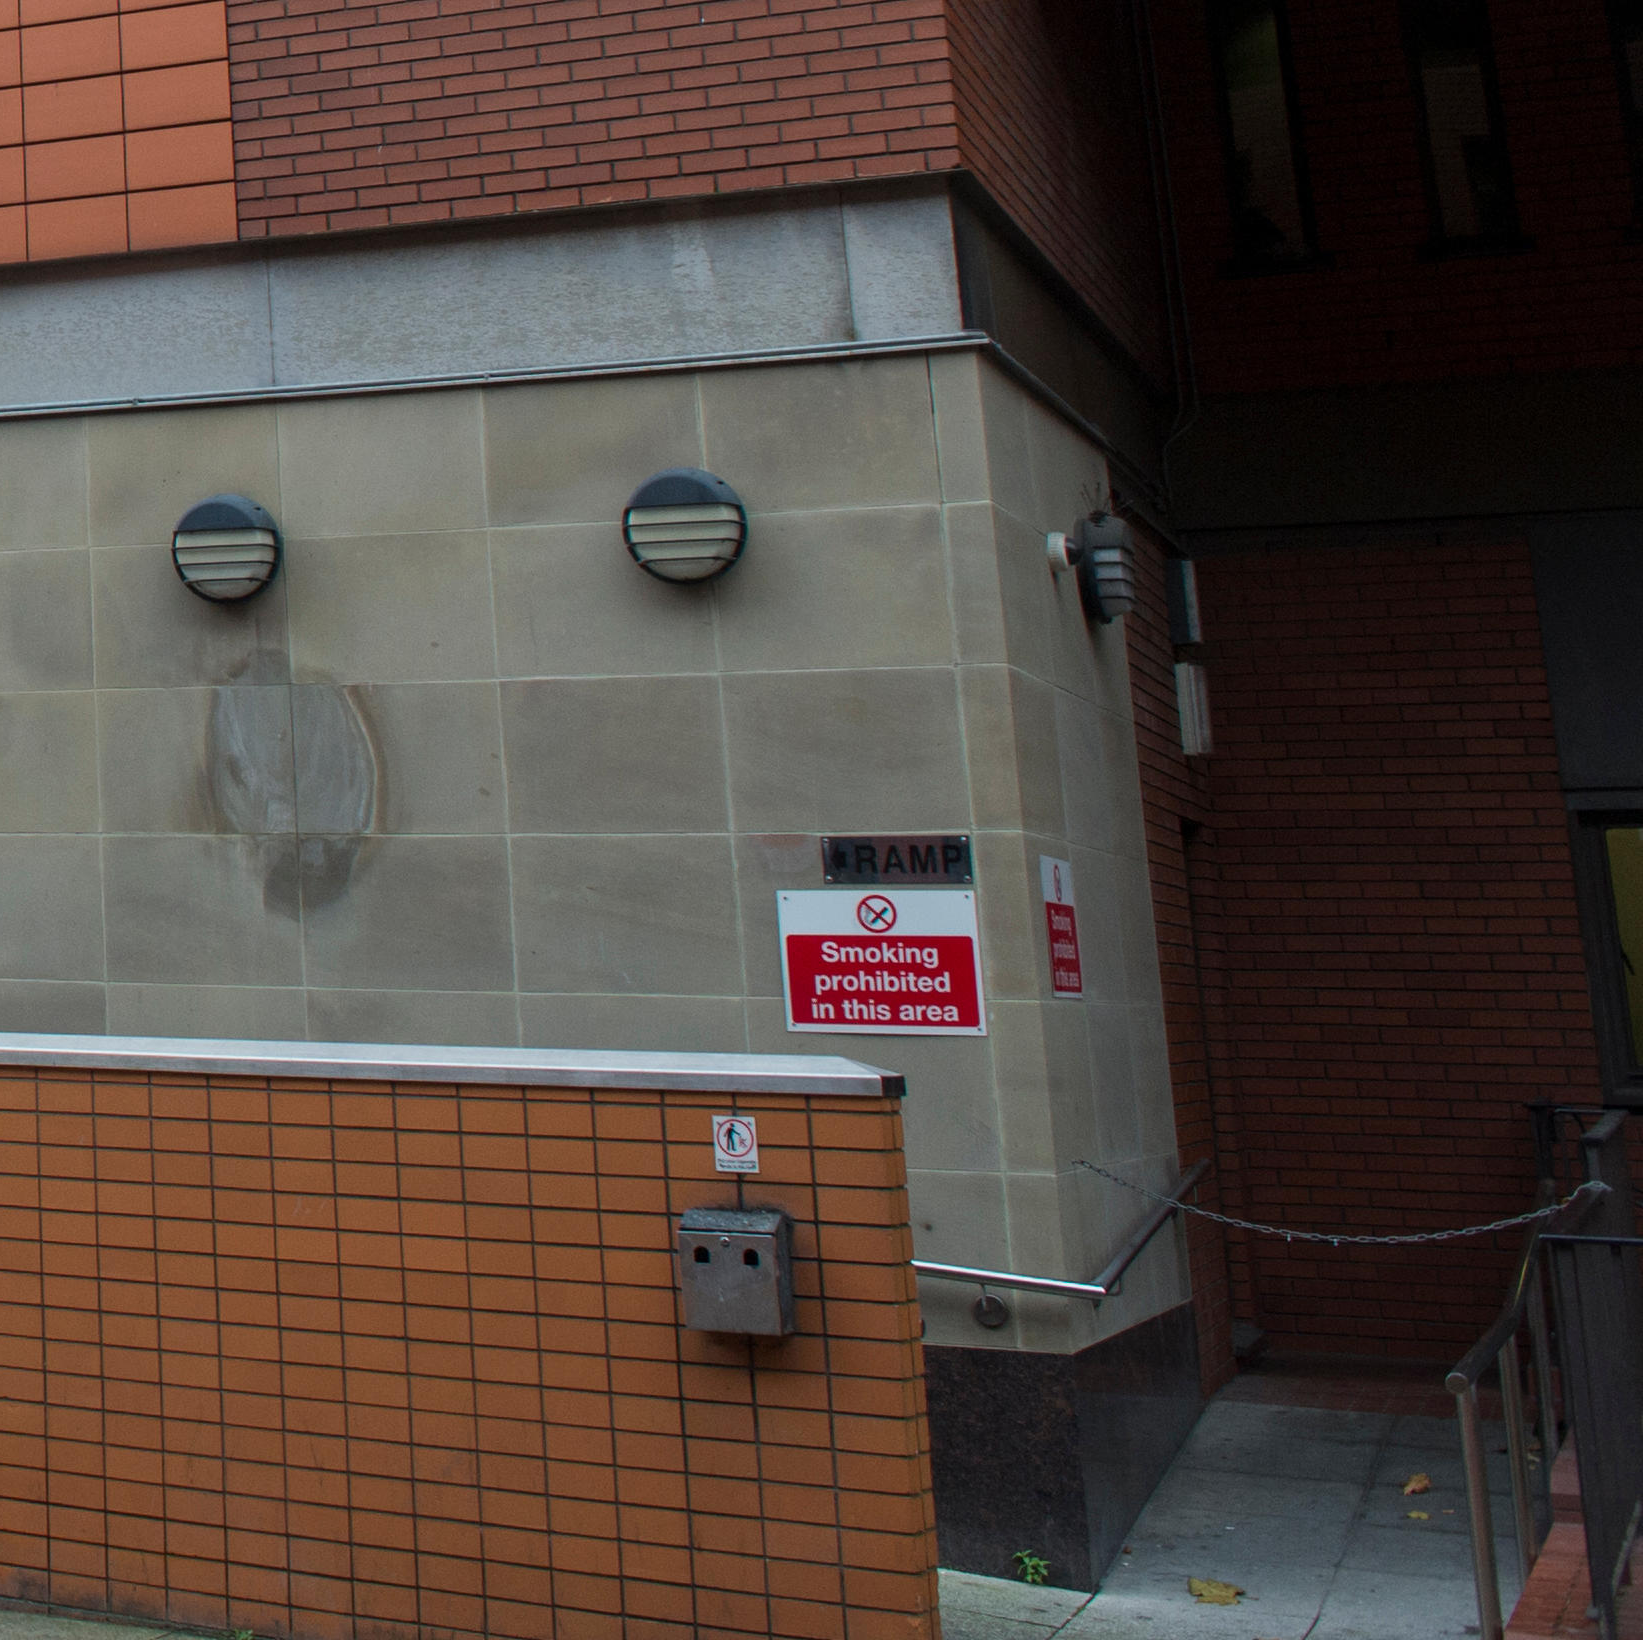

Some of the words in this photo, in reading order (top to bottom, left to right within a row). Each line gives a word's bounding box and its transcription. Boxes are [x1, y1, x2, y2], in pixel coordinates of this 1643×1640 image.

[854, 844, 962, 874] RAMP
[1051, 910, 1073, 936] Smoking
[820, 941, 940, 969] Smoking
[815, 971, 952, 995] prohibited
[811, 998, 835, 1019] in
[842, 998, 892, 1021] this
[899, 1004, 960, 1022] area
